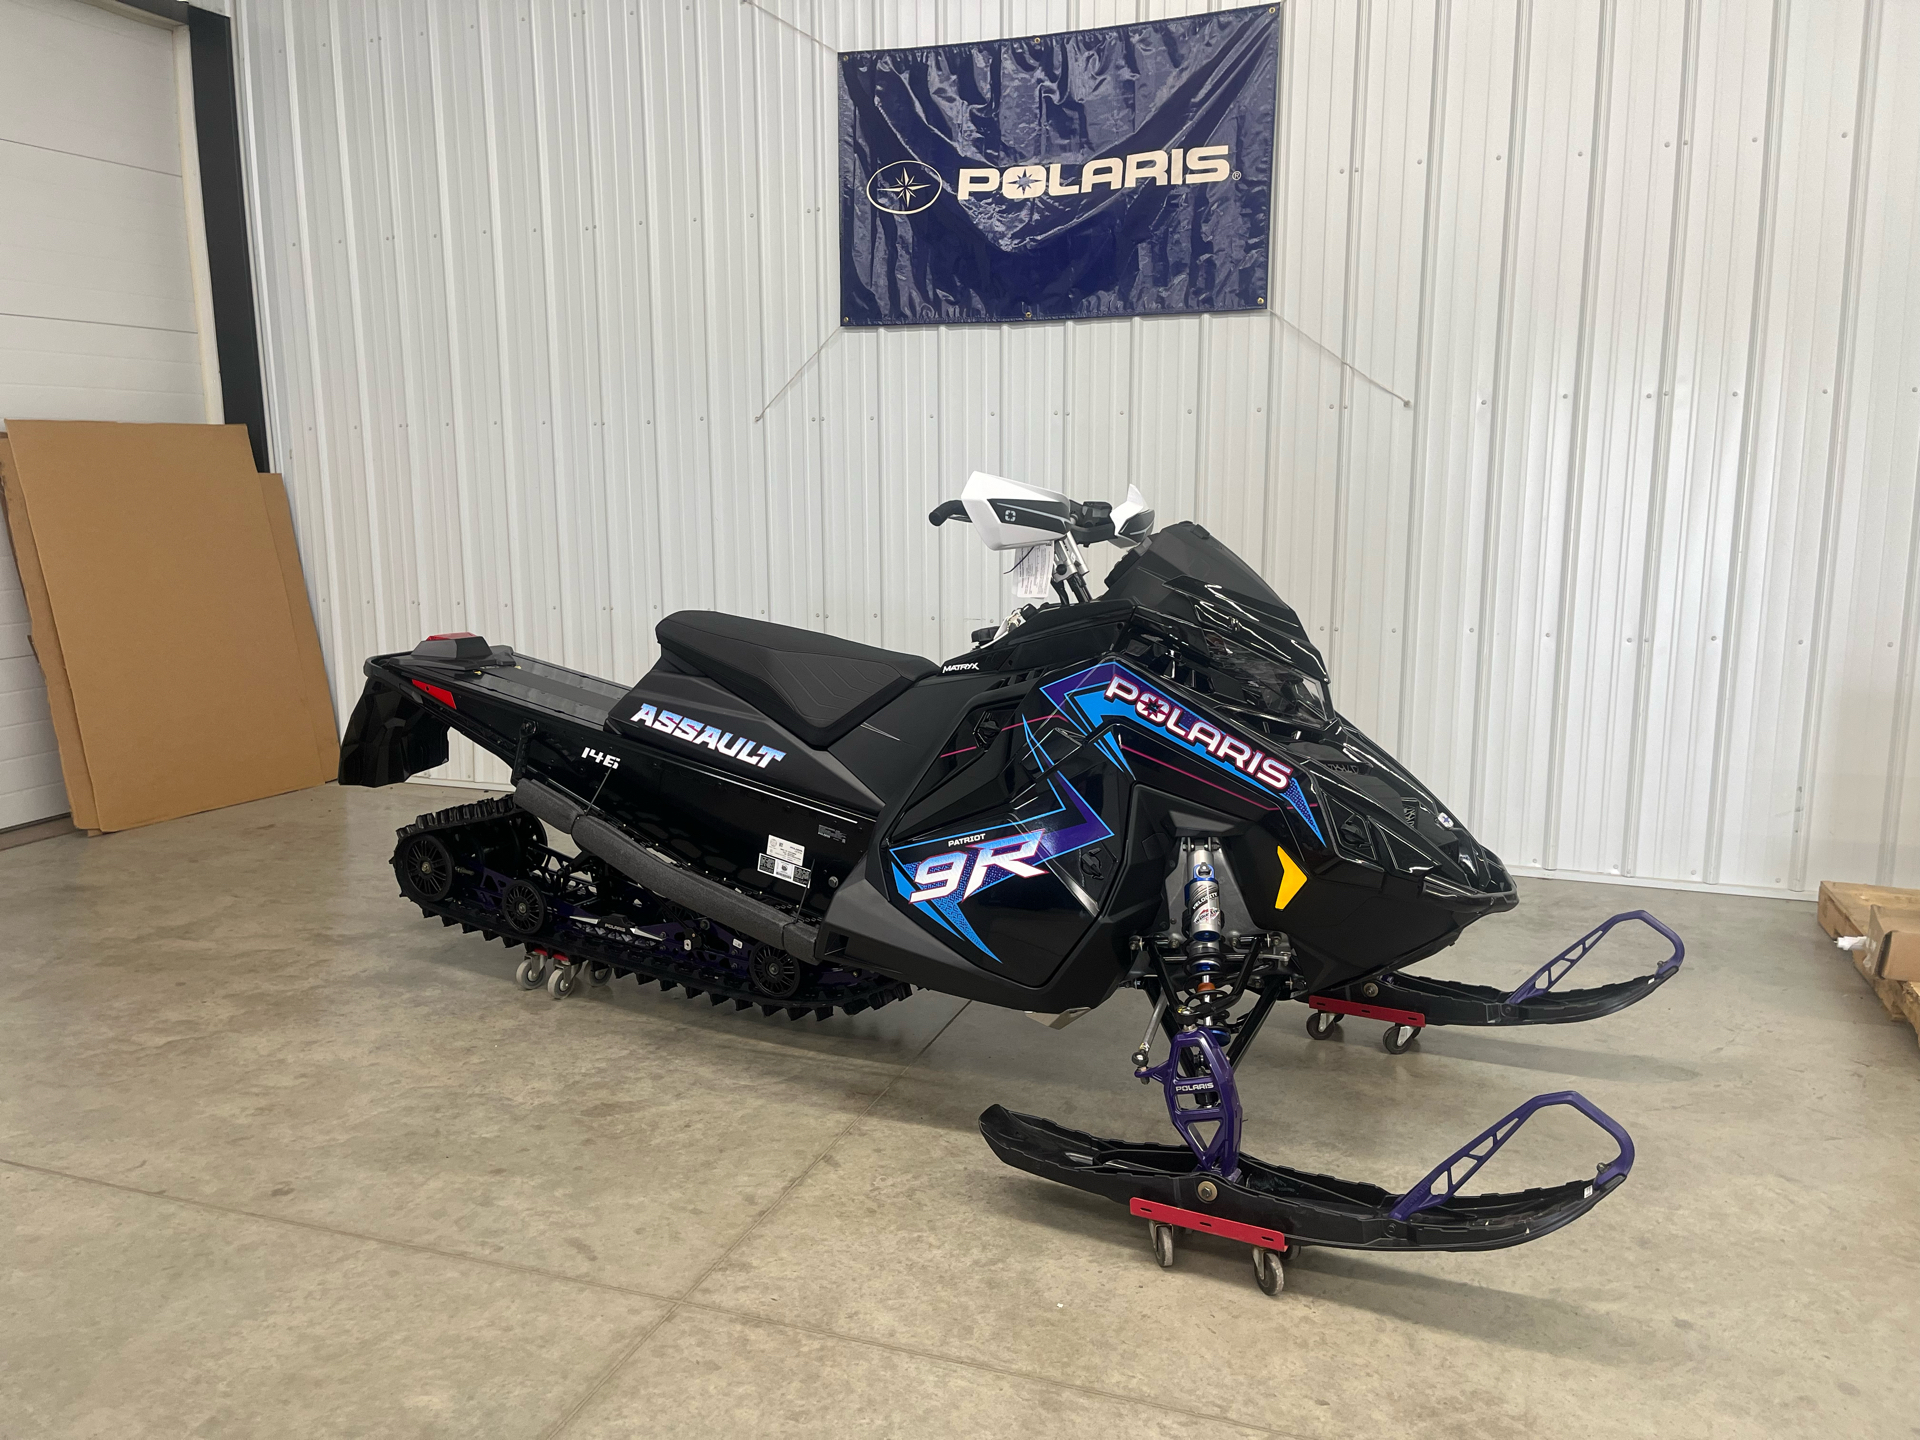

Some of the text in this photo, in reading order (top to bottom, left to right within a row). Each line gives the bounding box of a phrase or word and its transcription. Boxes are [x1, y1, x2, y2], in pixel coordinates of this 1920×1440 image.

[958, 145, 1230, 200] POLARIS
[942, 662, 980, 674] MATRYX
[630, 703, 786, 768] ASSAULT
[1104, 674, 1293, 790] POLARIS
[581, 746, 621, 769] 146
[948, 833, 986, 847] PATRIOT
[909, 828, 1049, 904] 9R
[1175, 1082, 1214, 1092] POLARIS
